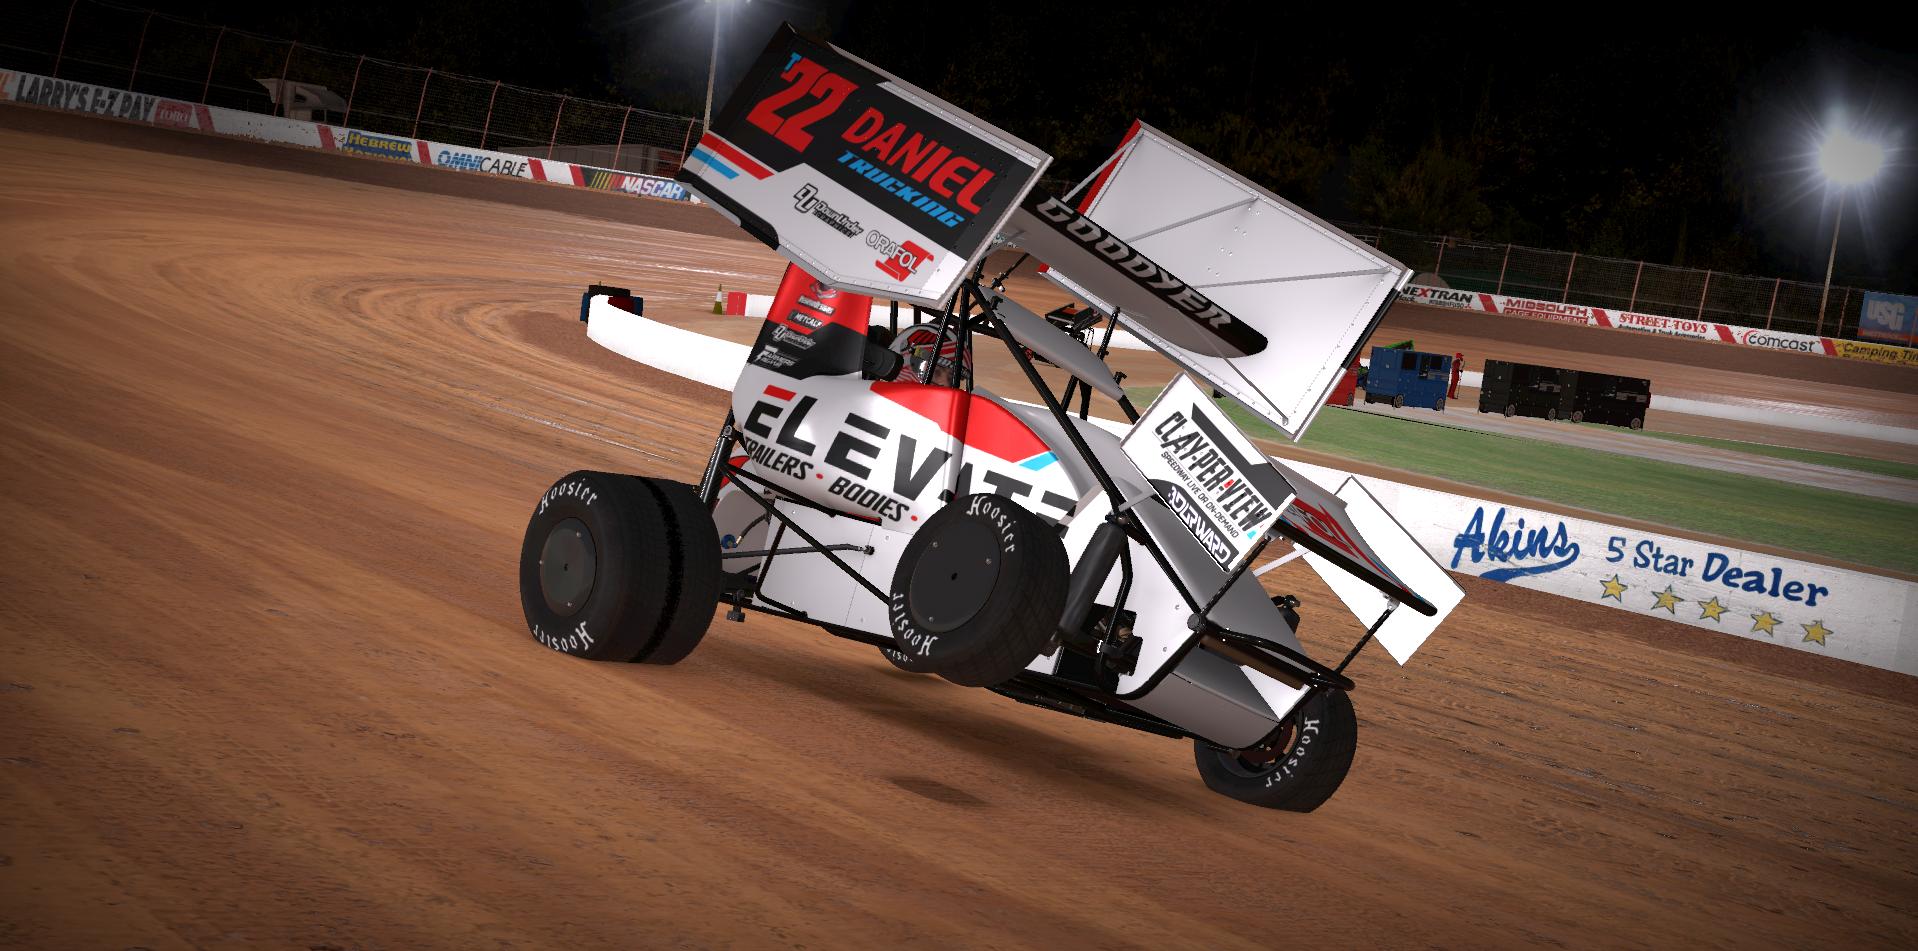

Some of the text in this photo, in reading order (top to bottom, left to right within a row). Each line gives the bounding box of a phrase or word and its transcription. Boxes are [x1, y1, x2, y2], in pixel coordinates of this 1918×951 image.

[16, 73, 90, 112] LARRY'S
[120, 96, 153, 120] PAY
[746, 57, 860, 153] 22
[349, 131, 412, 153] HEBREW
[841, 106, 995, 215] DANIEL
[621, 175, 684, 200] NASCAR
[836, 150, 967, 229] TRUCKING
[865, 230, 919, 275] ORAFOL
[1506, 298, 1587, 316] MIDSOUTH
[539, 477, 598, 515] Hoosier
[745, 437, 911, 523] TRAILERS BODIES
[1154, 410, 1273, 533] CLAY-PER-VIEW
[1160, 451, 1190, 485] SPEEDWAY
[1186, 480, 1201, 495] LIVE
[1206, 501, 1239, 539] ON-DEMAND
[966, 495, 1017, 552] Hoosier
[1450, 506, 1829, 607] Akins 5 Star Dealer
[533, 620, 595, 653] Hoosier
[892, 592, 938, 657] Hoosier
[1265, 717, 1320, 788] Hoosier
